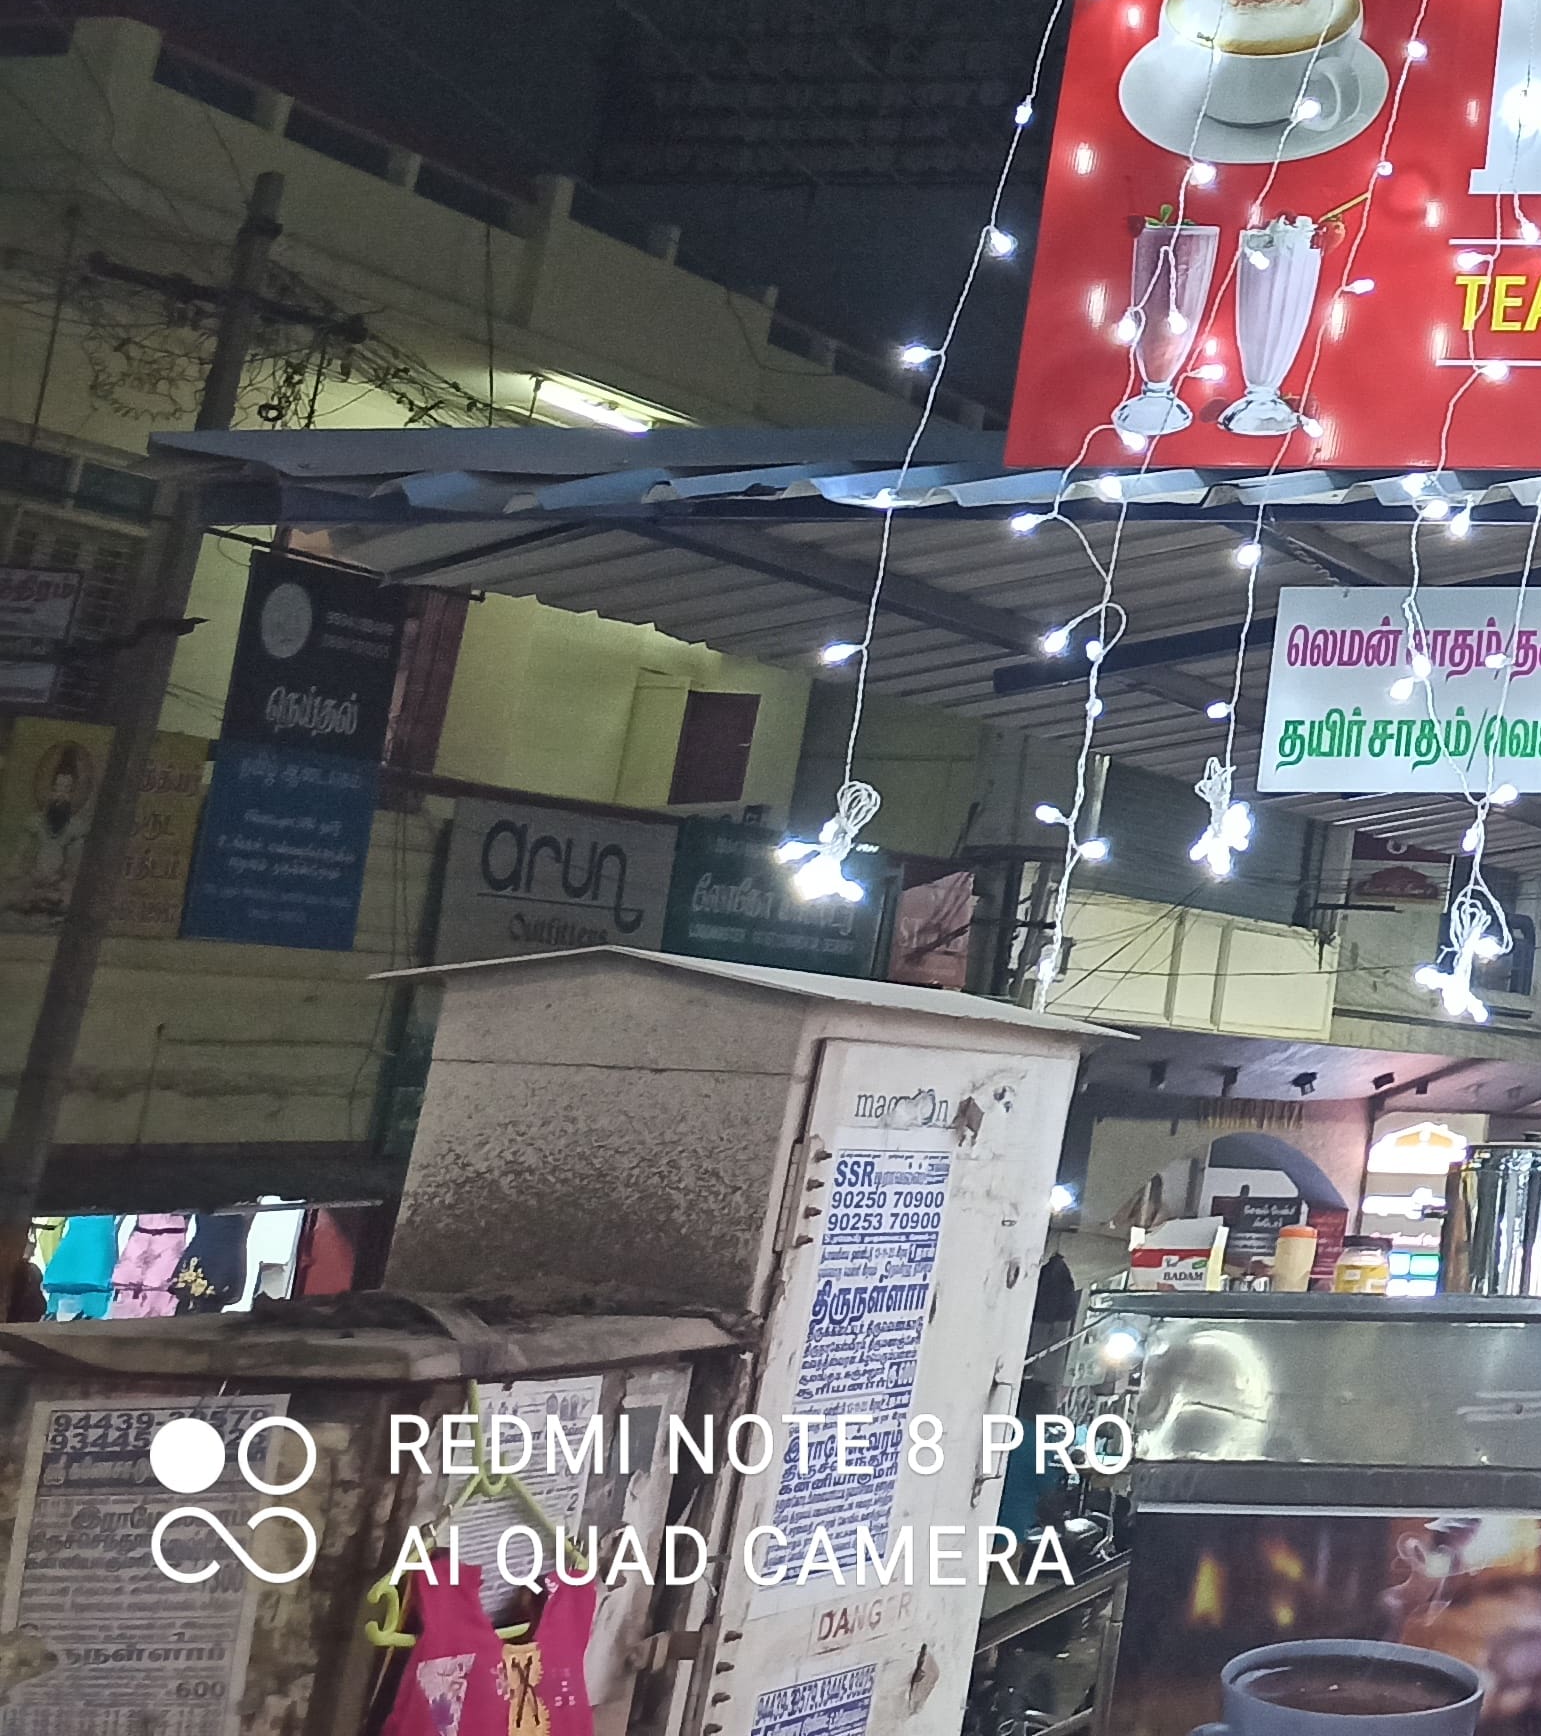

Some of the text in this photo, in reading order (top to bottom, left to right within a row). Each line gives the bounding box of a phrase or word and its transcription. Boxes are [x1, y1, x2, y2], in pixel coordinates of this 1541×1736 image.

[1286, 614, 1403, 669] லெமன்
[481, 818, 645, 934] arun
[834, 1160, 875, 1188] SSR
[831, 1191, 944, 1209] 90250 70900
[827, 1212, 940, 1231] 90253 70900
[817, 1591, 912, 1642] DANGR
